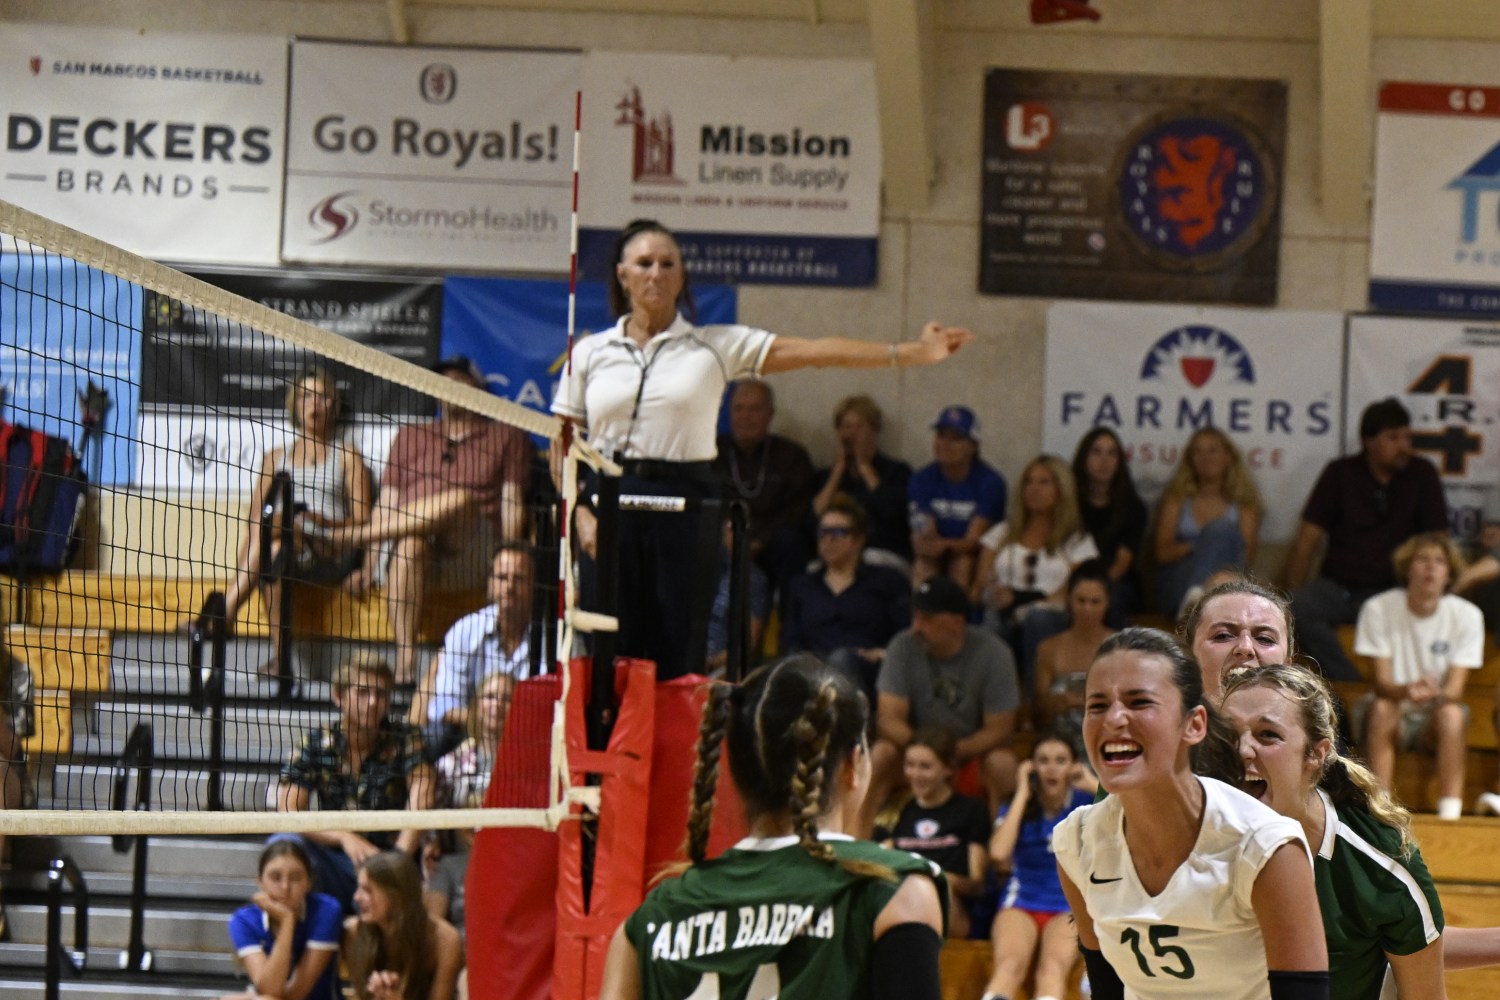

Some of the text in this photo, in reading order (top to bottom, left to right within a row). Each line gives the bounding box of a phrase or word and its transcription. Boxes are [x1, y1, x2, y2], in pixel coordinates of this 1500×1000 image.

[53, 61, 264, 85] SAN MARCOS BASKETBALL
[1449, 90, 1486, 110] GO
[7, 114, 272, 164] DECKERS
[313, 114, 558, 170] Go Royals!
[701, 125, 849, 157] Mission
[57, 168, 218, 199] BRANDS
[699, 163, 848, 190] Linen Supply
[1060, 391, 1333, 435] FARMERS
[647, 911, 727, 961] ANTA
[1120, 924, 1195, 980] 15
